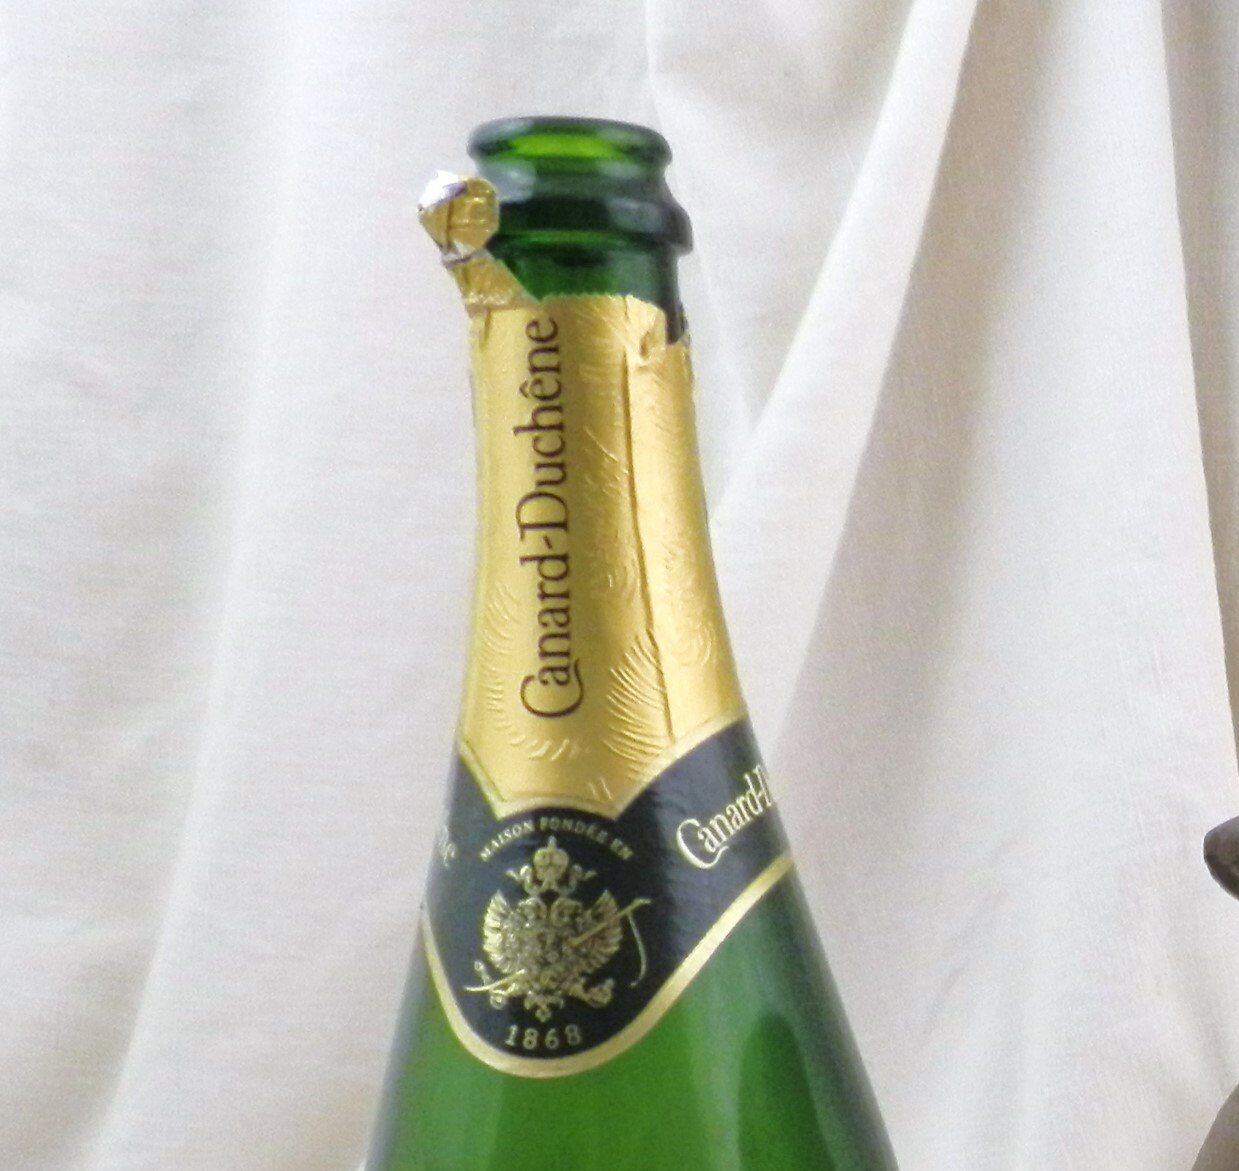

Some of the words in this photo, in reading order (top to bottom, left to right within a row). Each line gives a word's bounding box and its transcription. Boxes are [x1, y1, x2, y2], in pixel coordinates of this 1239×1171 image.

[513, 316, 585, 720] Canard-Duchêne
[480, 820, 535, 862] MAISON
[504, 1024, 583, 1050] 1868
